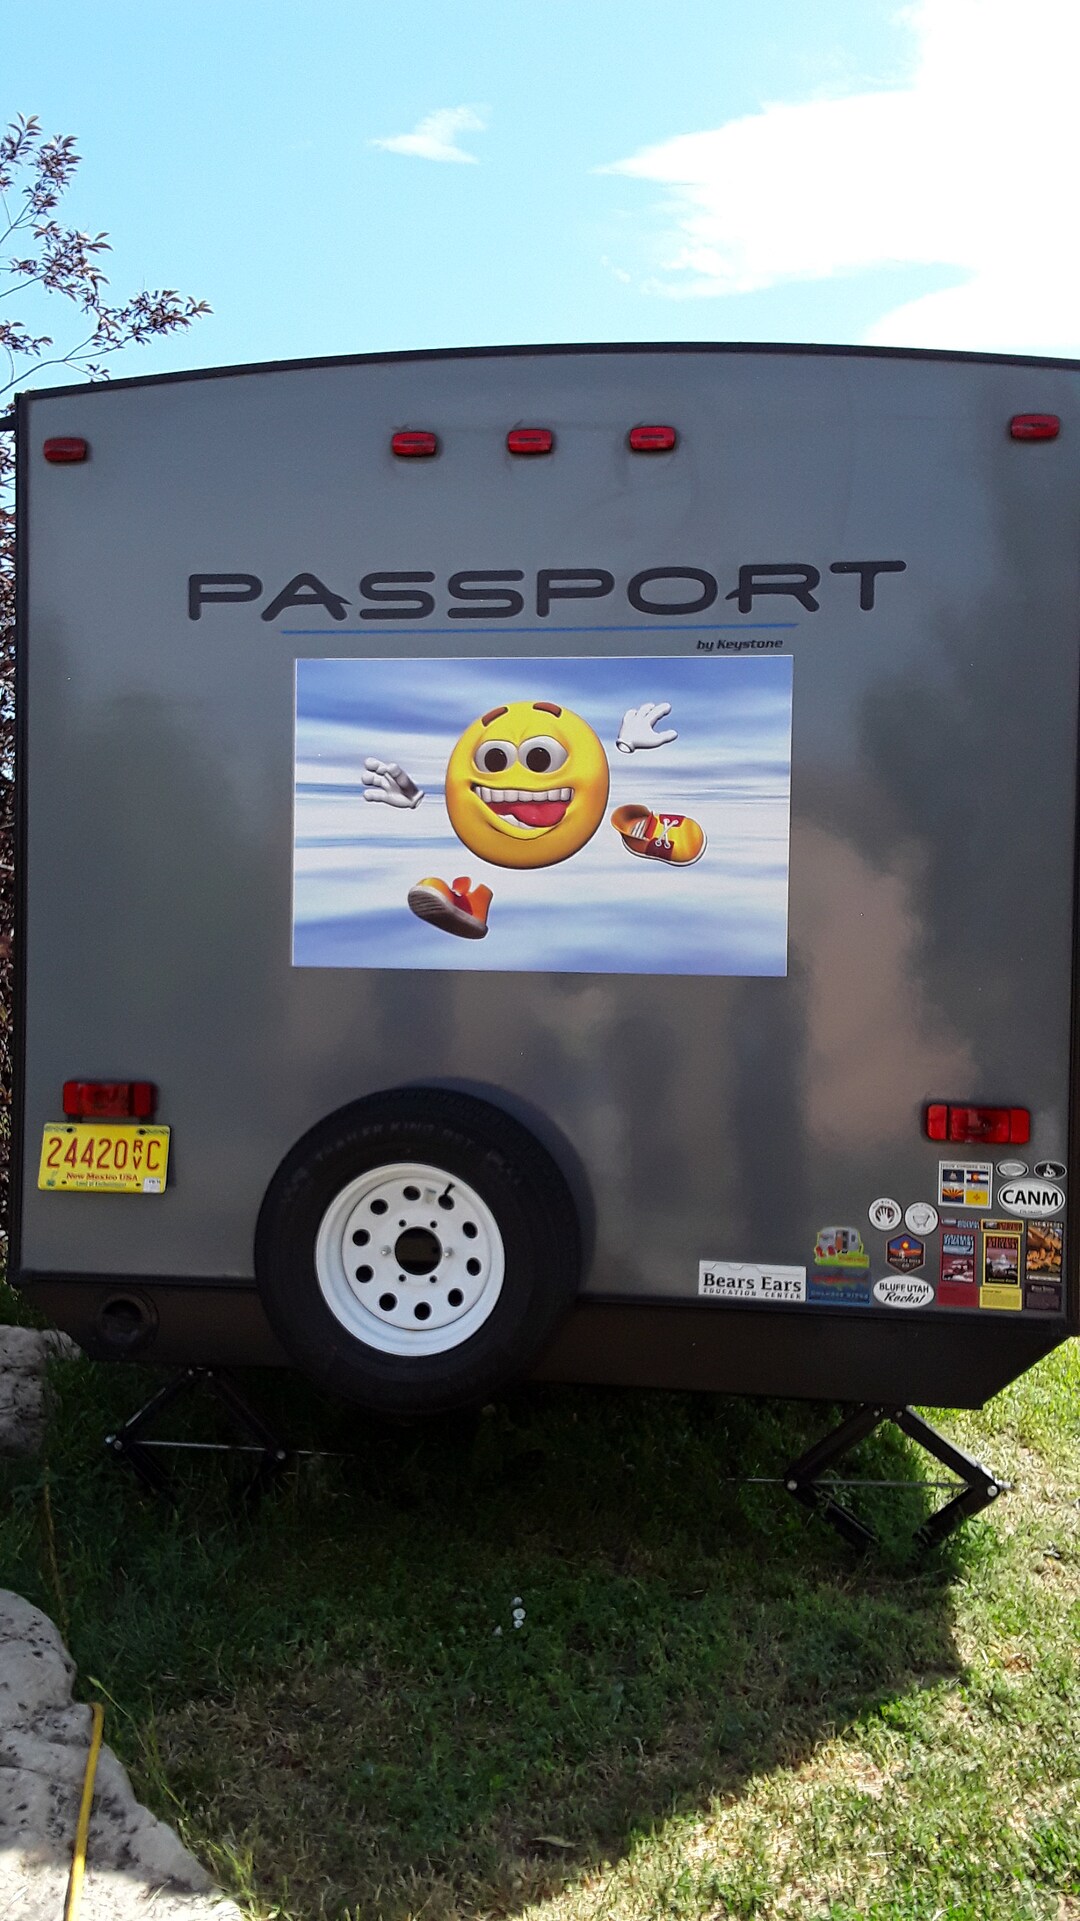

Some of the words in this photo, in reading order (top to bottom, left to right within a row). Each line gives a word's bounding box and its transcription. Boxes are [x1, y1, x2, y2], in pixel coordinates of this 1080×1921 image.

[189, 560, 906, 621] PASSPORT
[696, 640, 714, 652] by
[717, 639, 783, 651] Keystone
[66, 1172, 84, 1180] New
[86, 1172, 118, 1181] Mexico
[120, 1173, 138, 1182] USA
[1002, 1189, 1059, 1206] CANM
[703, 1272, 755, 1289] Bears
[761, 1276, 802, 1293] Ears
[879, 1282, 905, 1292] BLUFF
[907, 1283, 929, 1294] UTAH
[703, 1287, 757, 1297] EDUCATION
[764, 1291, 801, 1300] CENTER
